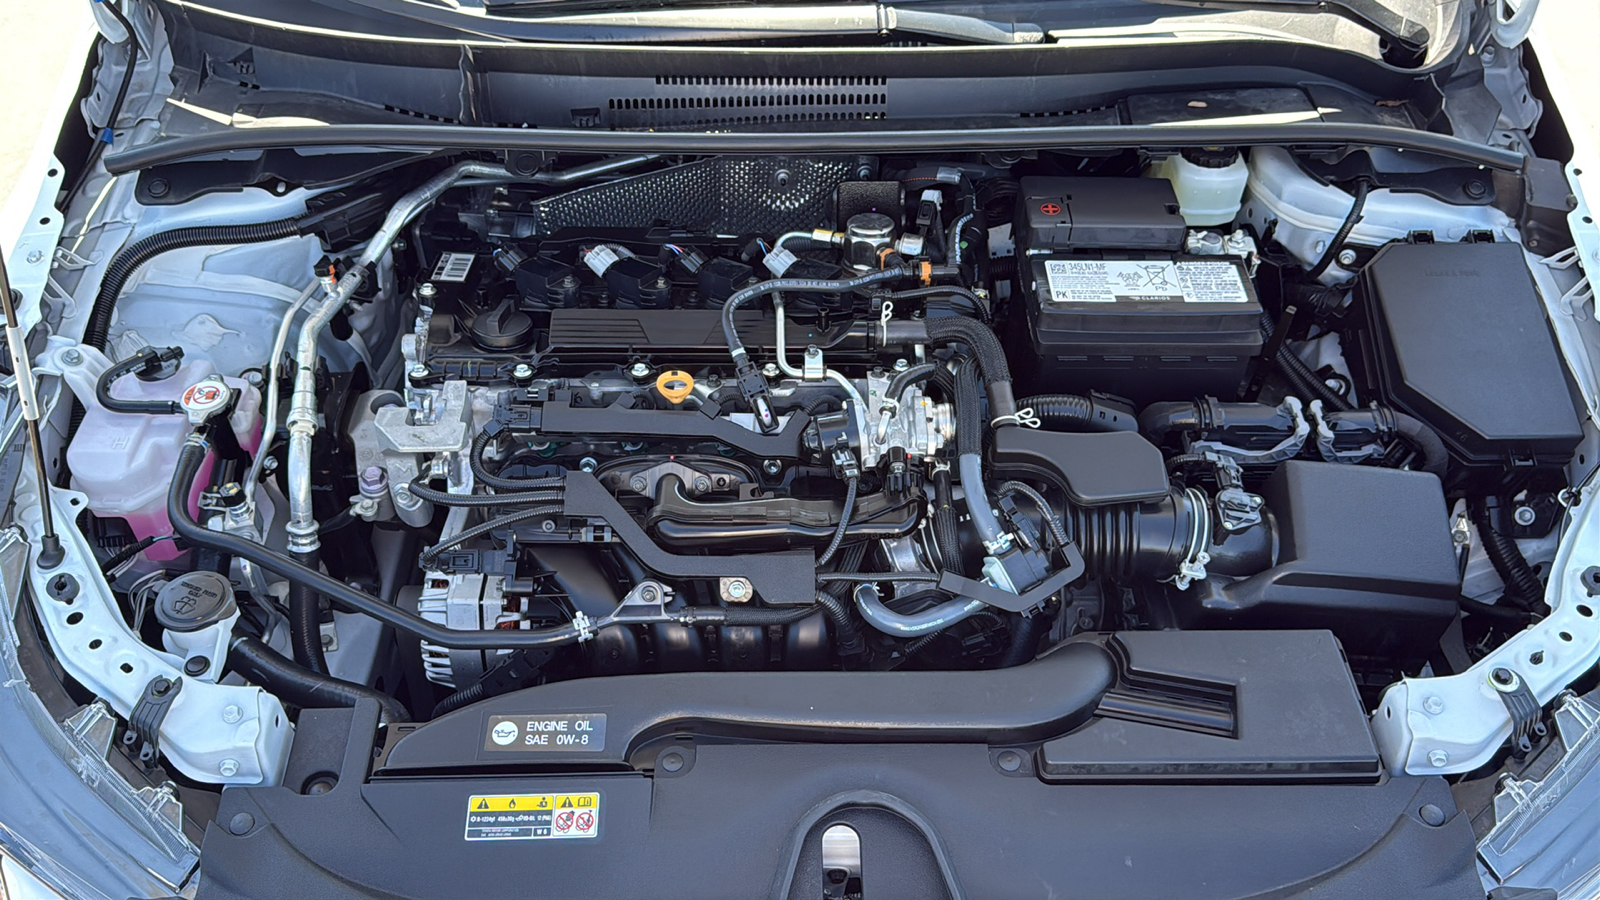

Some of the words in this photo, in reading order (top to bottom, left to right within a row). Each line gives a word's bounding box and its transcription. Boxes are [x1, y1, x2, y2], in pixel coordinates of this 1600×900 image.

[1056, 291, 1068, 299] PK
[526, 721, 568, 731] ENGINE
[574, 720, 593, 731] OIL
[524, 735, 549, 745] SAE
[556, 735, 589, 745] 0W-8
